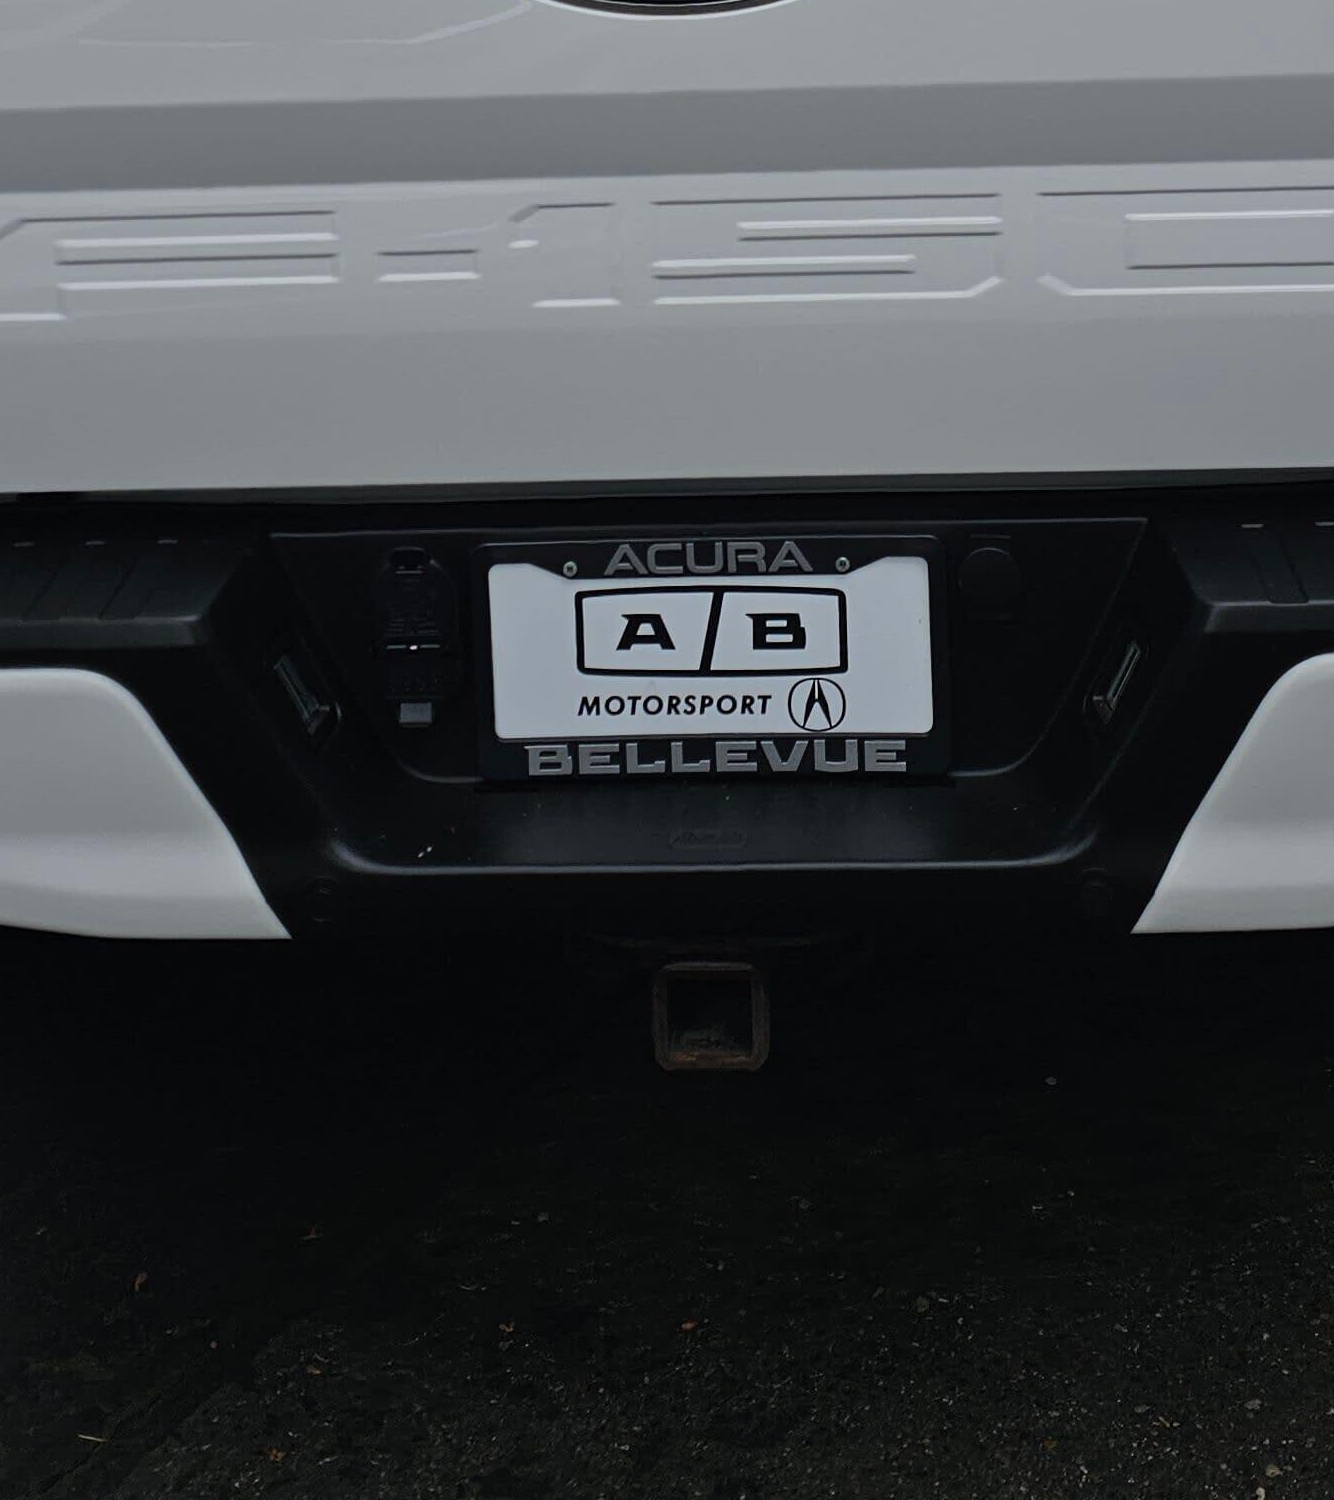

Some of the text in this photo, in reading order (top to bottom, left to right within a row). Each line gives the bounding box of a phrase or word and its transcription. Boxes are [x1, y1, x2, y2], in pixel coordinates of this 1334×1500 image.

[604, 541, 814, 576] ACURA
[577, 694, 772, 718] MOTORSPORT
[523, 739, 907, 777] BELLEVUE
